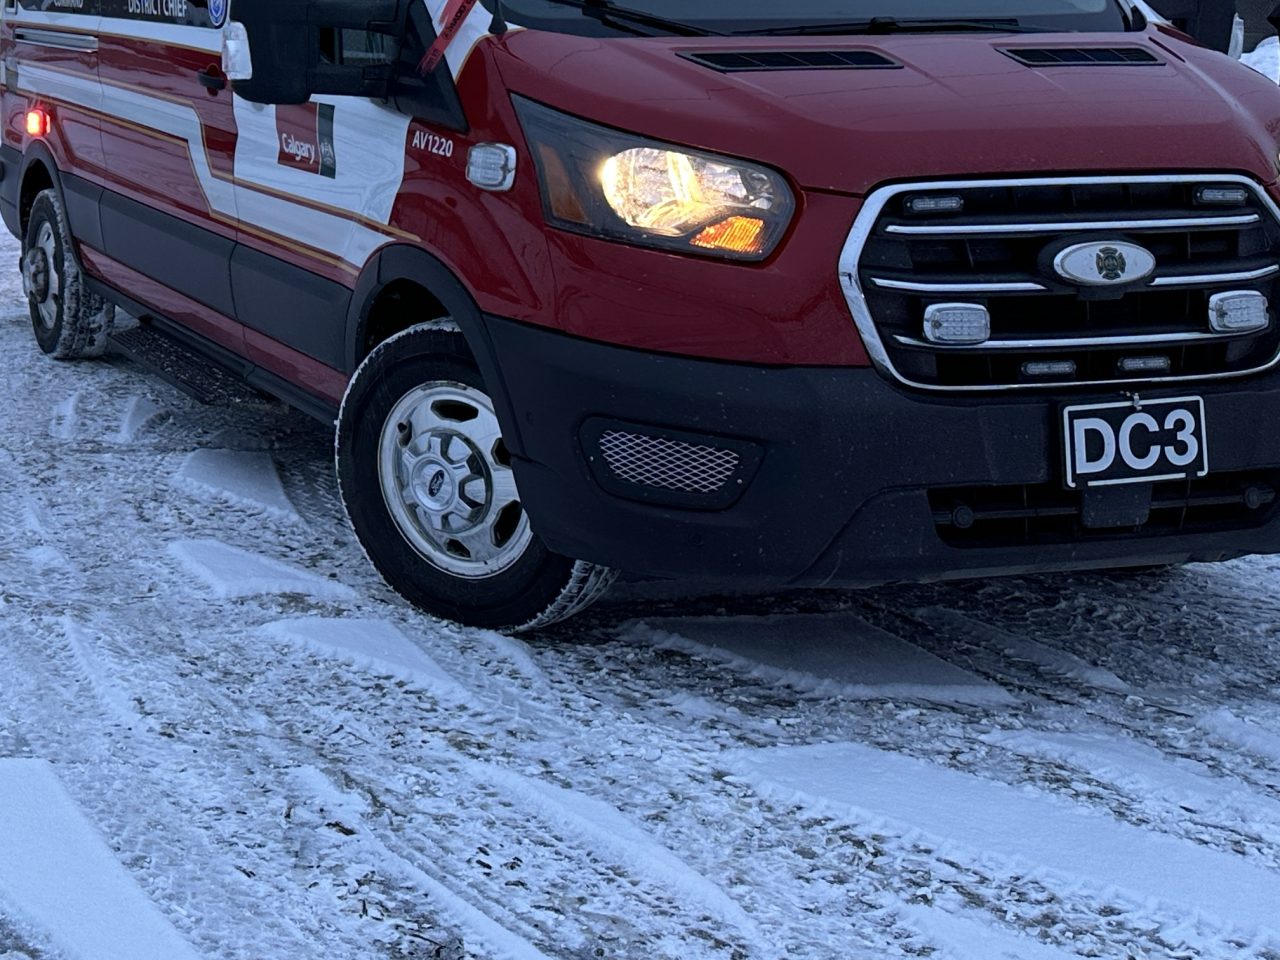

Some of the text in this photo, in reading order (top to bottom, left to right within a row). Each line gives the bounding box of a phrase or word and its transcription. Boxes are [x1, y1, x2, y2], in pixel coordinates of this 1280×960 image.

[282, 133, 316, 164] Calgary
[412, 131, 453, 157] AV1220
[1073, 408, 1199, 474] DC3
